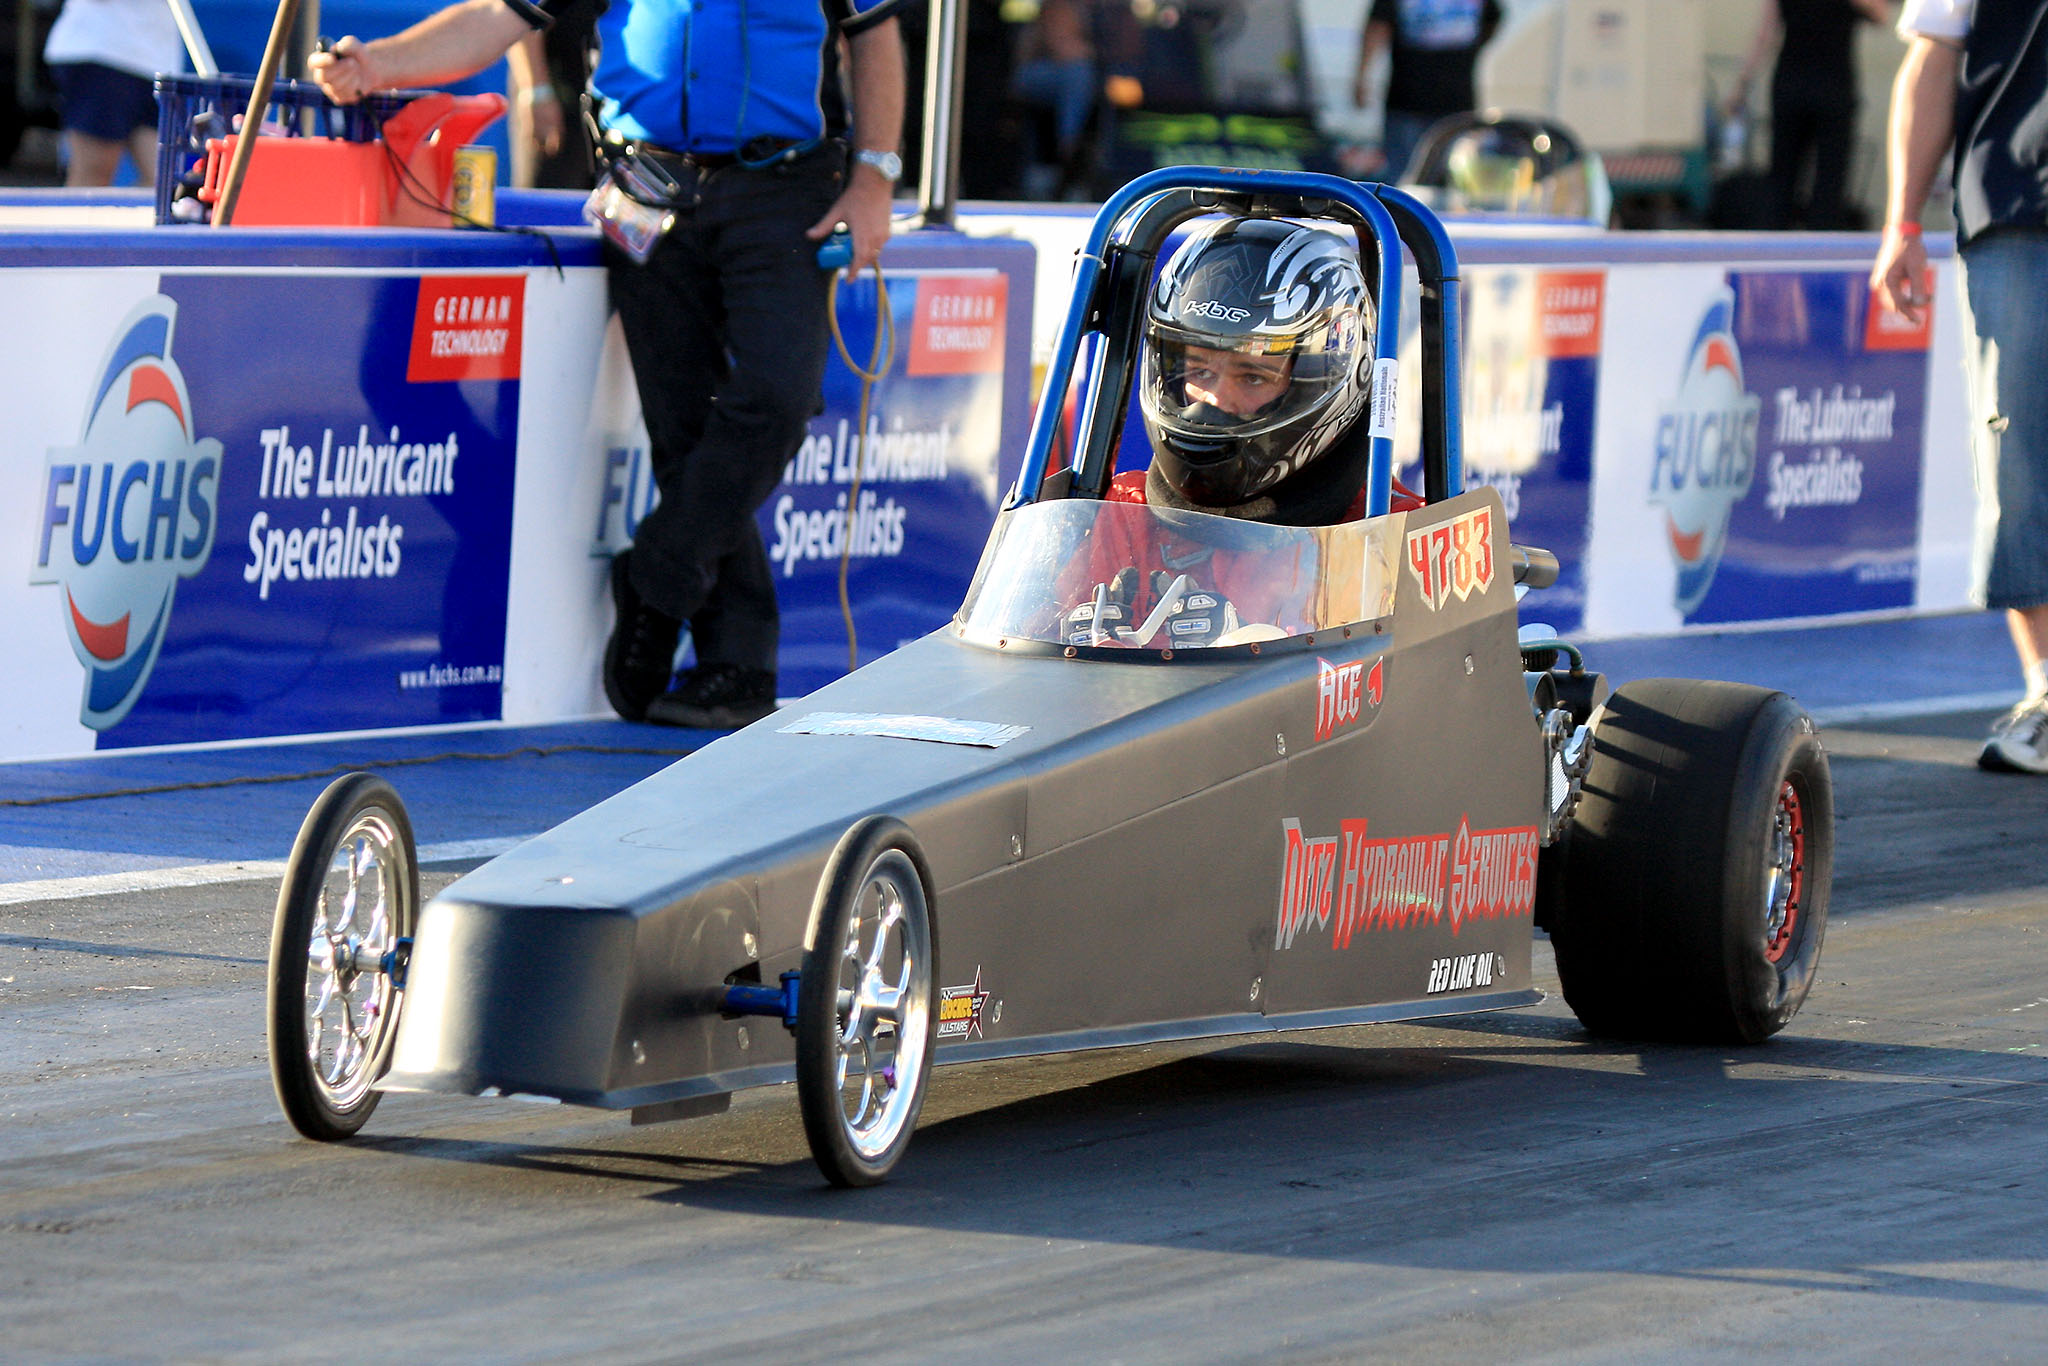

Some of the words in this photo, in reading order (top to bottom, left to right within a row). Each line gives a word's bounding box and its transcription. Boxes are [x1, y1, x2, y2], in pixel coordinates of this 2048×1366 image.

[431, 330, 509, 357] TECHNOLOGY
[434, 295, 511, 323] GERMAN
[833, 415, 949, 482] Lubricant
[1776, 387, 1810, 443] The
[1811, 382, 1896, 443] Lubricant
[259, 426, 311, 498] The
[317, 424, 458, 496] Lubricant
[1649, 411, 1759, 491] FUCHS
[1766, 448, 1863, 521] Specialists
[38, 457, 216, 566] FUCHS
[770, 490, 906, 577] Specialists
[243, 507, 403, 600] Specialists
[1408, 506, 1493, 611] 4783
[400, 663, 502, 688] www.fuchs.com.au
[1315, 657, 1363, 741] ACE
[1426, 958, 1452, 994] RED
[1450, 954, 1477, 990] LINE
[1475, 952, 1495, 987] OIL
